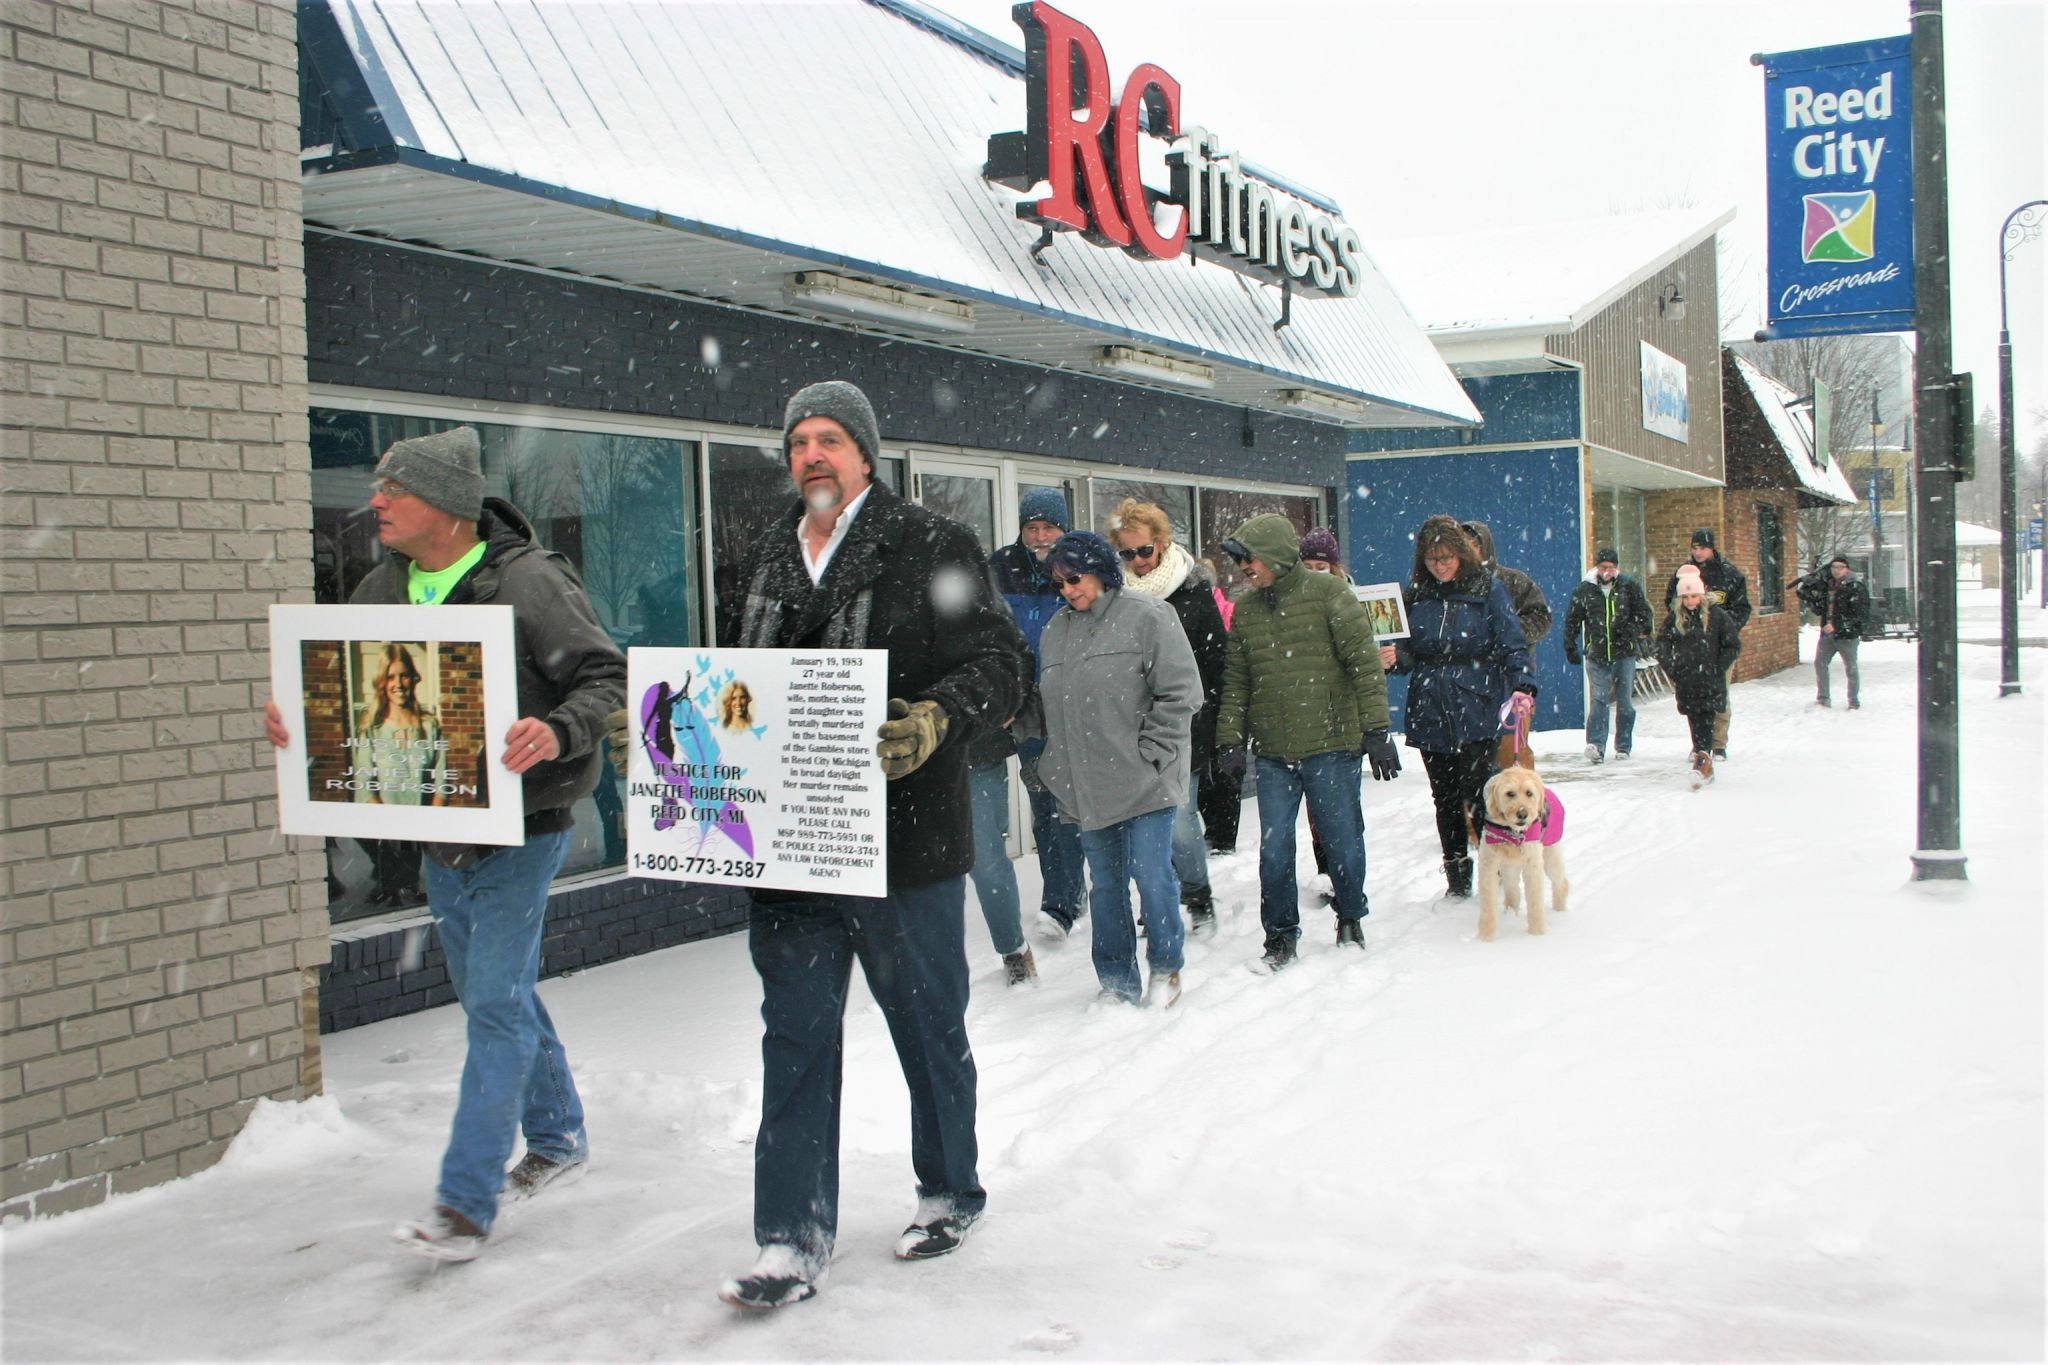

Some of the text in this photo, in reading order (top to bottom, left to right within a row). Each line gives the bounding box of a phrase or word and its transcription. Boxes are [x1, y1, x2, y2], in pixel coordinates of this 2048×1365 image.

[1784, 71, 1893, 129] Reed
[1014, 0, 1361, 297] RC fitness
[1793, 130, 1886, 184] City
[1780, 262, 1900, 313] Crossroads
[791, 657, 862, 667] January 19, 1983
[816, 671, 834, 679] year
[837, 670, 850, 678] old
[789, 682, 818, 690] Janette
[789, 707, 804, 715] and
[807, 707, 844, 717] daughter
[788, 719, 863, 729] brutally murdered
[792, 731, 800, 739] in
[818, 732, 859, 741] basement
[340, 738, 450, 750] JUSTICE
[793, 744, 805, 752] the
[848, 746, 869, 754] store
[372, 752, 427, 765] FOR
[792, 756, 811, 764] Reed
[814, 756, 829, 767] City
[832, 758, 870, 768] Michigan
[342, 766, 459, 780] JANETTE
[655, 762, 741, 780] JUSTICE FOR
[790, 768, 861, 780] in broad daylight
[326, 779, 477, 795] ROBERSON
[783, 780, 868, 792] Her murder remains
[630, 782, 766, 803] JANETTE ROBERSON
[651, 805, 744, 823] REED CITY, MI
[781, 804, 870, 817] IF YOU HAVE ANY INFO
[799, 818, 852, 829] PLEASE CALL
[778, 829, 795, 838] MSP
[862, 834, 873, 842] OR
[773, 841, 783, 849] RC
[786, 842, 815, 851] POLICE
[634, 853, 766, 878] 1-800-773-2587
[778, 853, 874, 868] ANY LAW ENFORCEMENT
[809, 868, 841, 878] AGENCY
